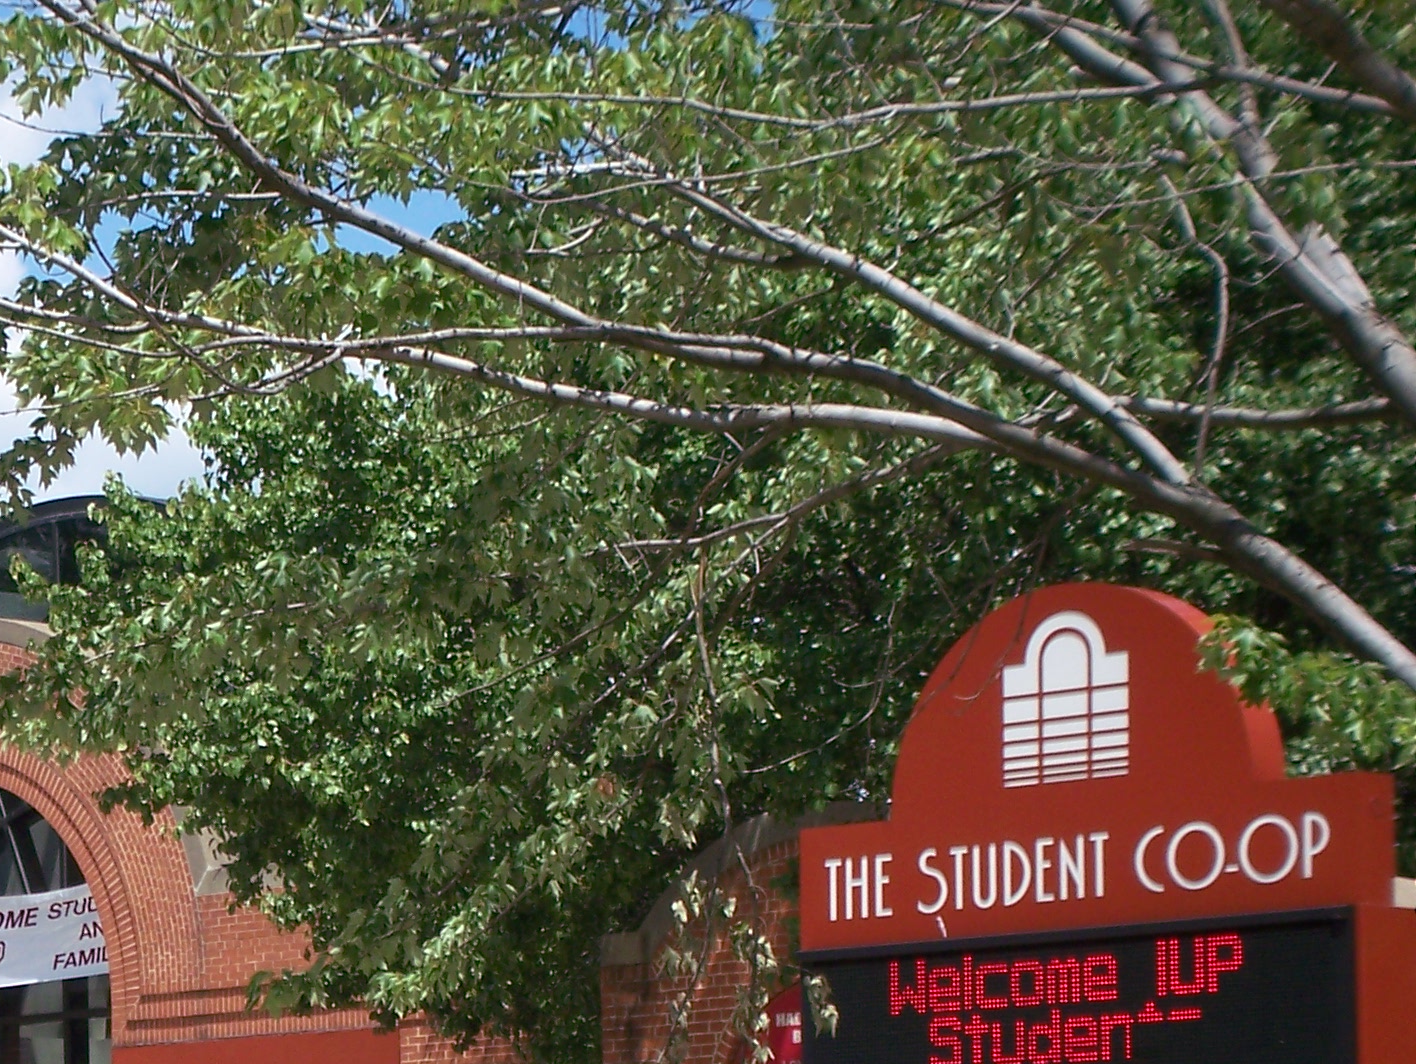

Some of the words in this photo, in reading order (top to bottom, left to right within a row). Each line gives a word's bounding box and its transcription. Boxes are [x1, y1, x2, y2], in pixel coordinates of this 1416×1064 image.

[824, 853, 893, 922] THE
[917, 831, 1110, 914] STUDENT
[1134, 811, 1331, 892] CO-OP
[888, 953, 1119, 1017] Welcome
[1154, 933, 1245, 998] IUP
